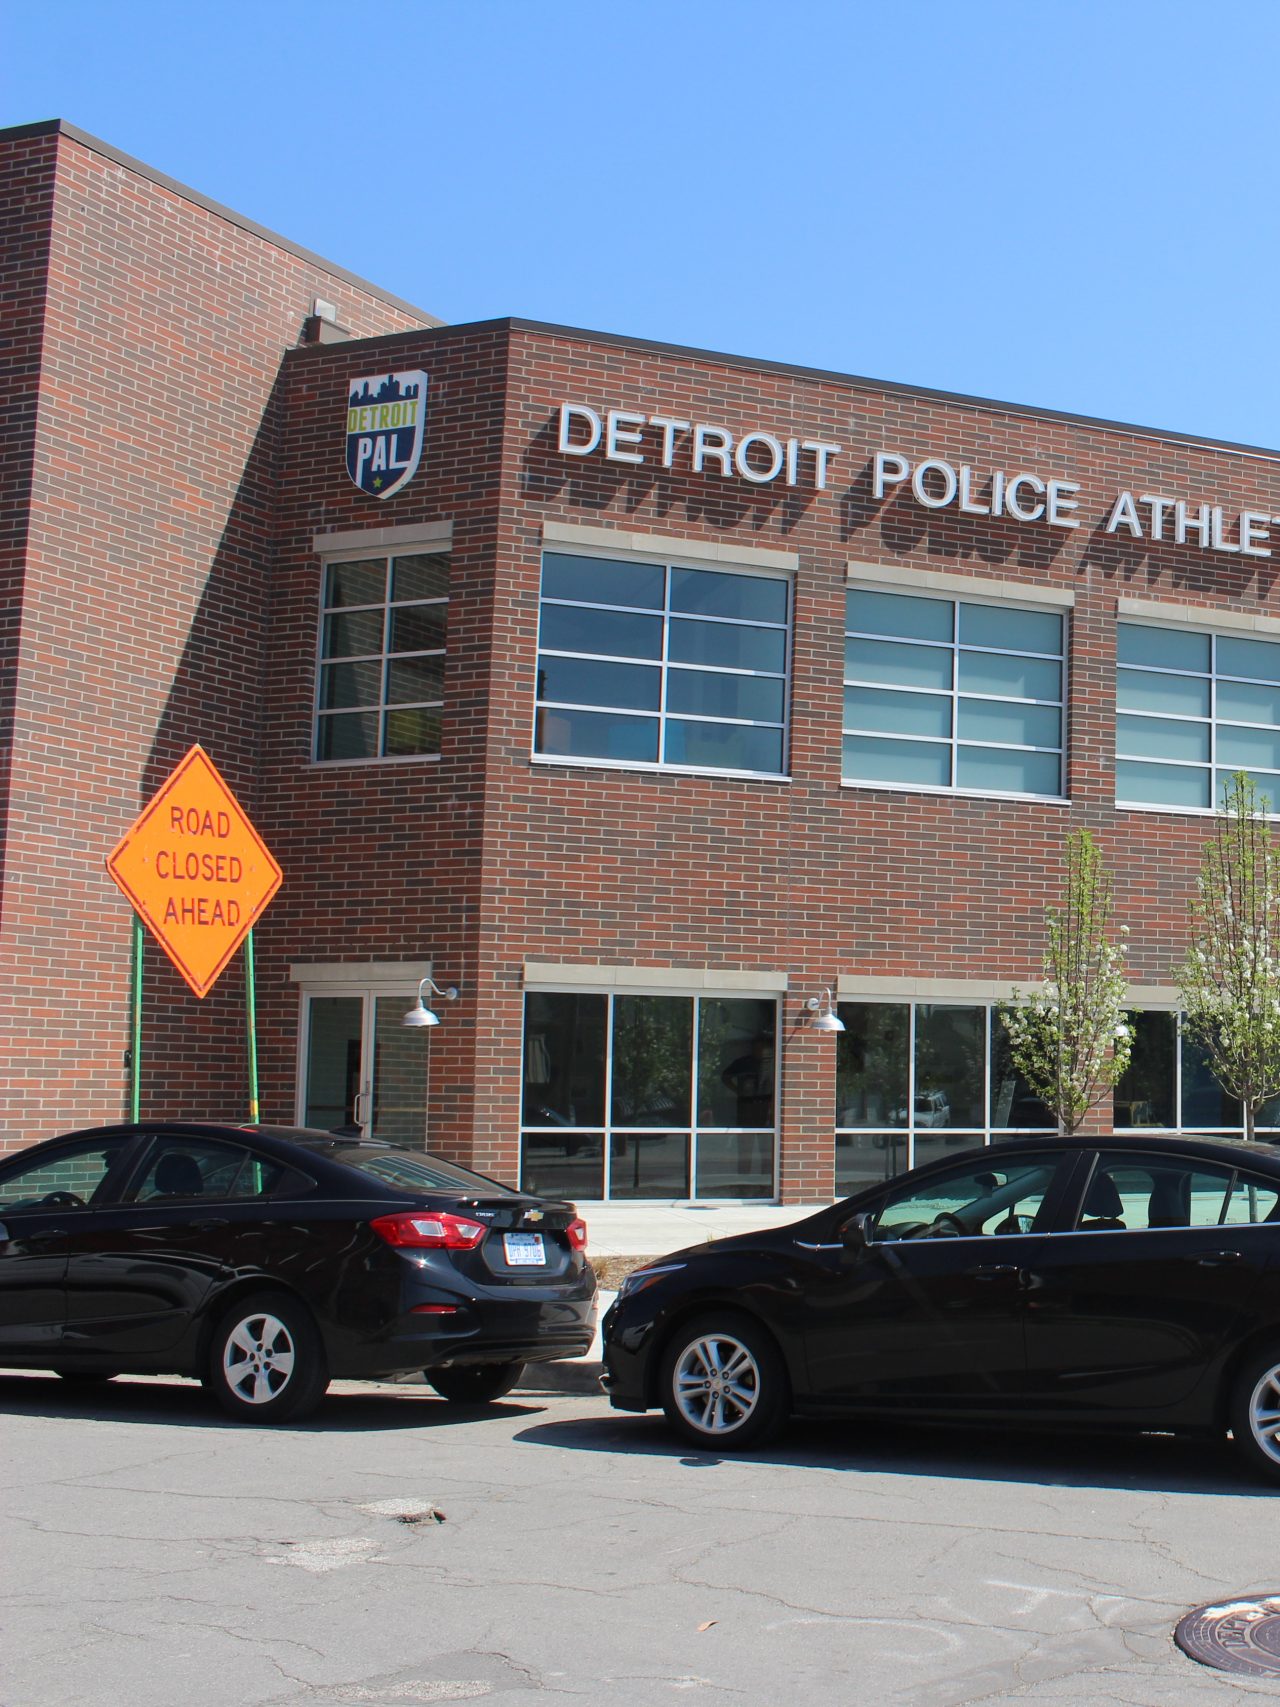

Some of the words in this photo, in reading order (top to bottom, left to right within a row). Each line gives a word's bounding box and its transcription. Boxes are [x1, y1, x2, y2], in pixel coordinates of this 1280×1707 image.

[348, 400, 418, 433] DETROIT
[355, 434, 412, 488] PAL
[558, 402, 842, 489] DETROIT
[872, 450, 1080, 528] POLICE
[170, 805, 230, 839] ROAD
[155, 850, 242, 884] CLOSED
[163, 896, 241, 927] AHEAD
